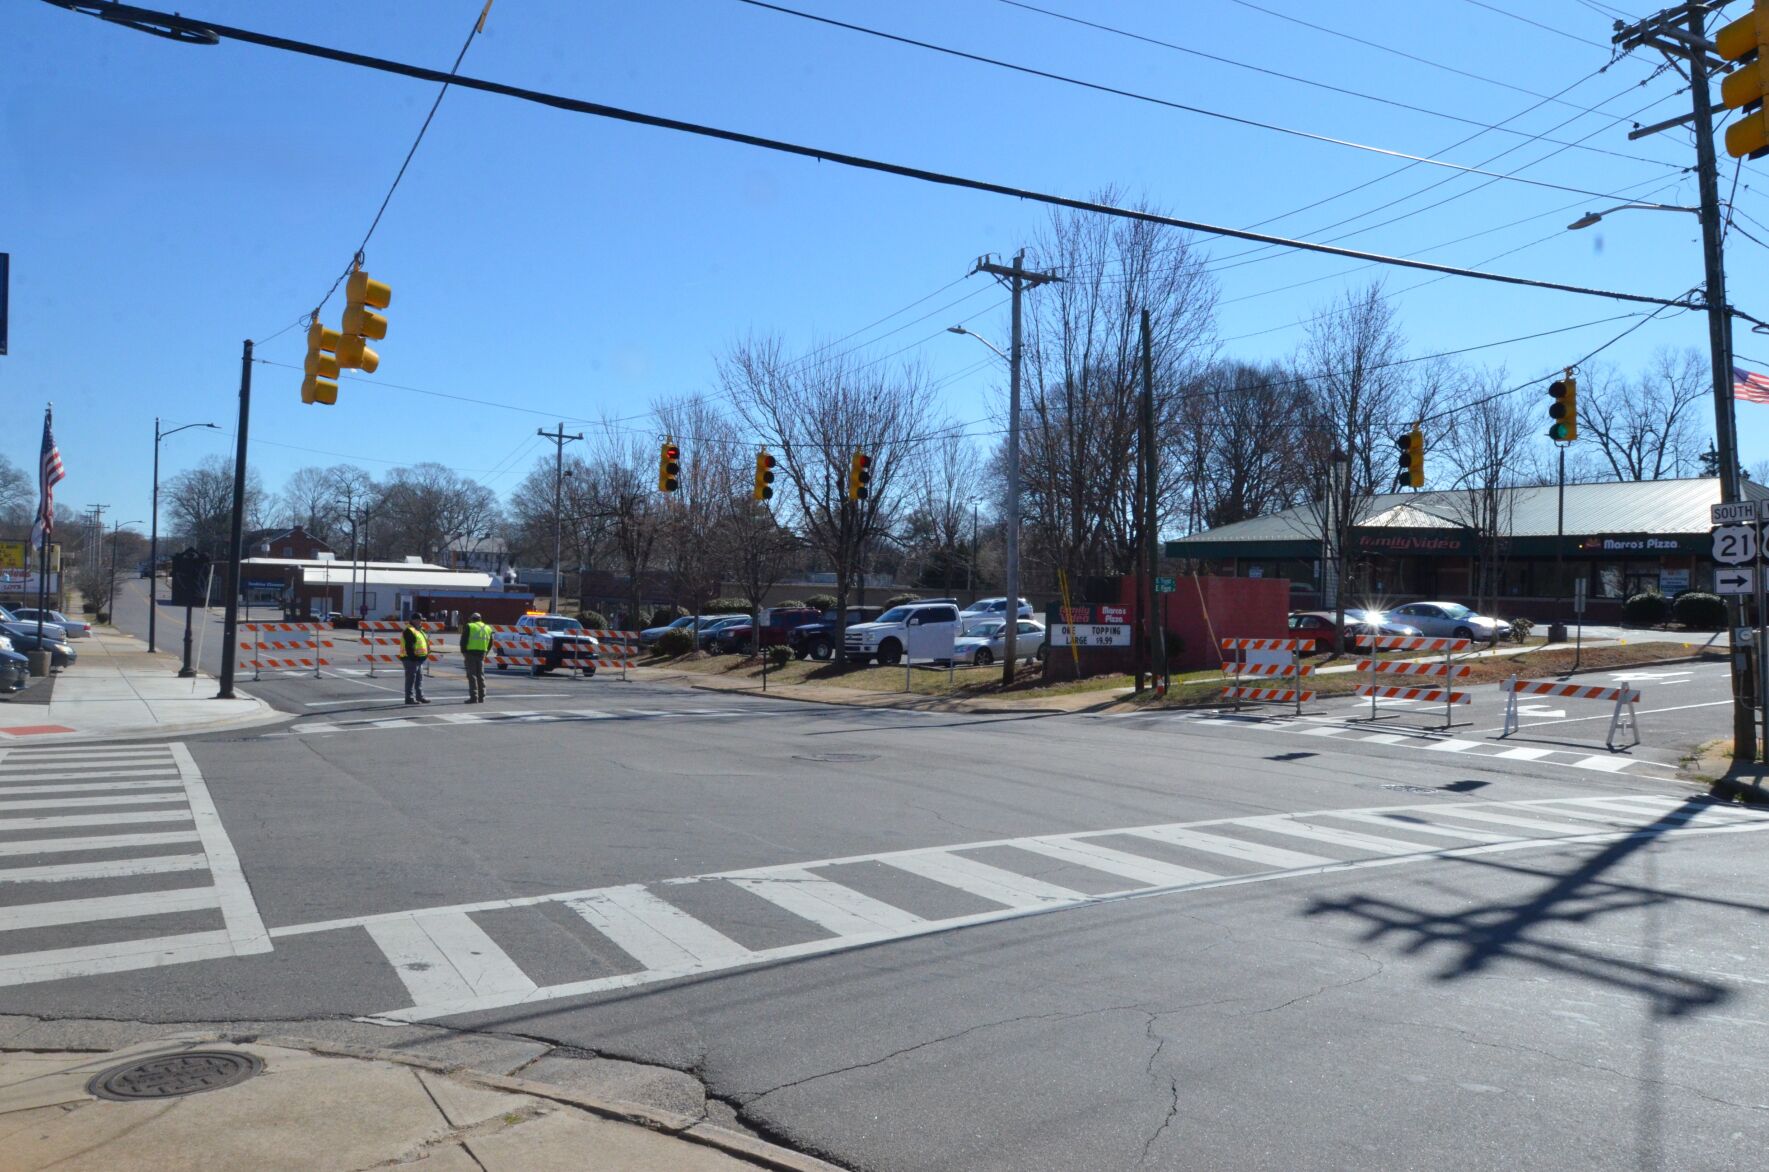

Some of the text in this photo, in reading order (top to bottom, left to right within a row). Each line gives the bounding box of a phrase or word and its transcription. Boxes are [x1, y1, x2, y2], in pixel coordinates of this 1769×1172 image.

[1714, 505, 1752, 519] SOUTH
[1647, 539, 1678, 549] Pizza
[1721, 534, 1748, 557] 21
[1102, 606, 1126, 615] Marco's
[1105, 614, 1123, 623] Pizza
[1092, 626, 1121, 635] TOPPING
[1066, 636, 1113, 645] LRGE $9.99
